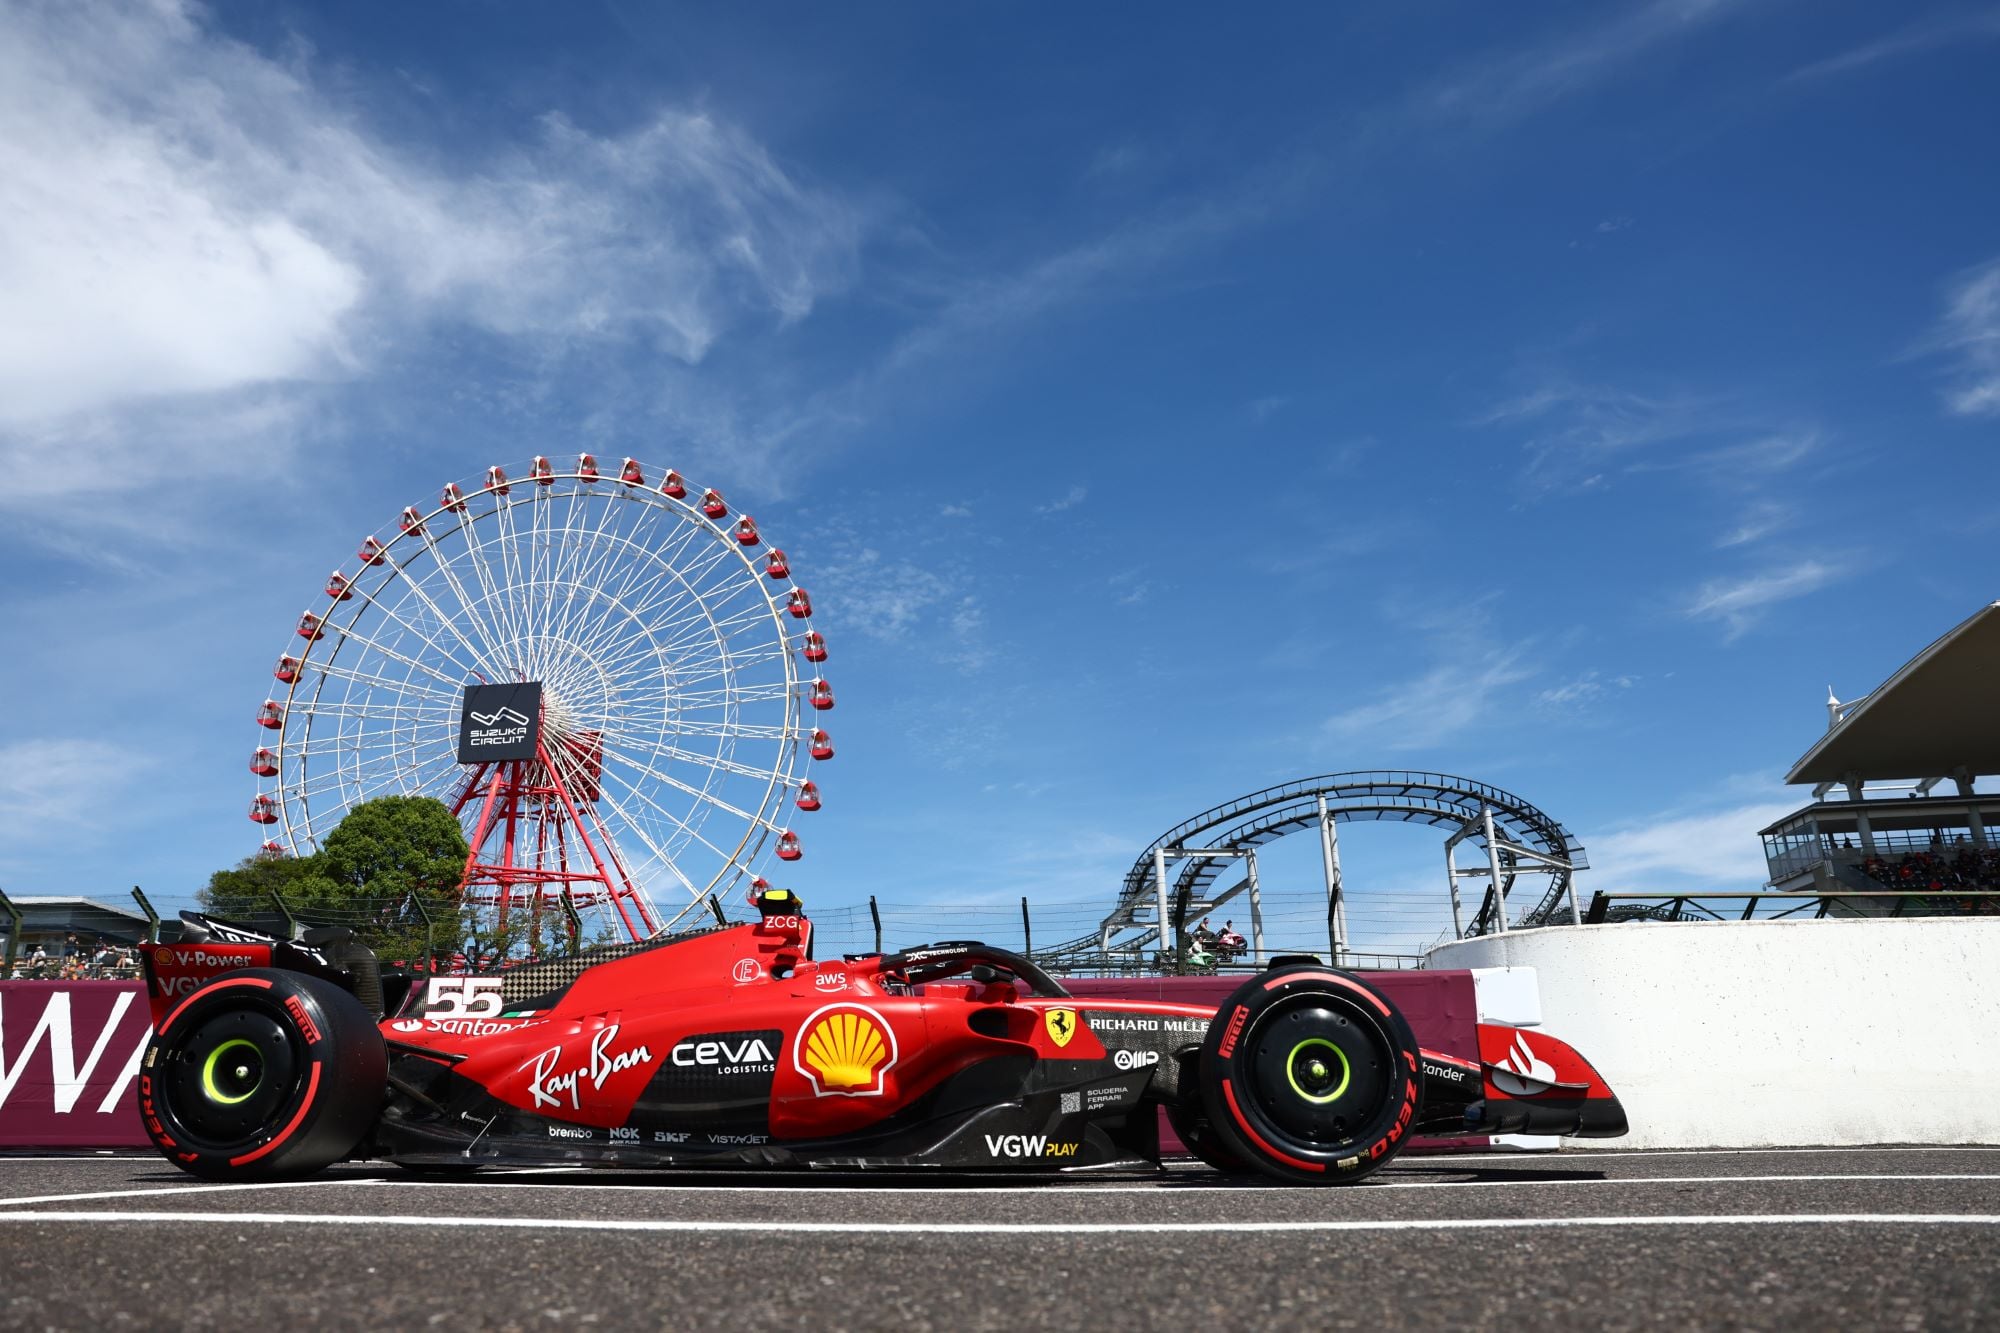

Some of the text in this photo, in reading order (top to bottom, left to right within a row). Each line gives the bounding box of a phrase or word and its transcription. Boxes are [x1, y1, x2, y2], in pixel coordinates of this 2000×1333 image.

[470, 727, 527, 738] SUZUKA
[470, 735, 525, 746] CIRCUIT
[765, 916, 798, 929] ZCG
[176, 950, 252, 967] V-Power
[906, 947, 968, 962] DXC TECHNOLOGY
[815, 973, 846, 986] aws
[424, 977, 503, 1019] 55
[284, 994, 321, 1045] PIRELLI
[1090, 1019, 1211, 1032] RICHARD MILLE
[1218, 1004, 1250, 1059] PIRELLI
[718, 1064, 775, 1075] LOGISTICS
[1422, 1061, 1465, 1082] tander
[1087, 1086, 1129, 1097] SCUDERIA
[1087, 1094, 1122, 1104] FERRARI
[1370, 1050, 1417, 1160] P ZERO
[1087, 1102, 1105, 1111] APP
[549, 1126, 593, 1139] brembo
[609, 1127, 640, 1139] NGK
[654, 1131, 691, 1143] SKF
[984, 1134, 1079, 1157] VGW PLAY
